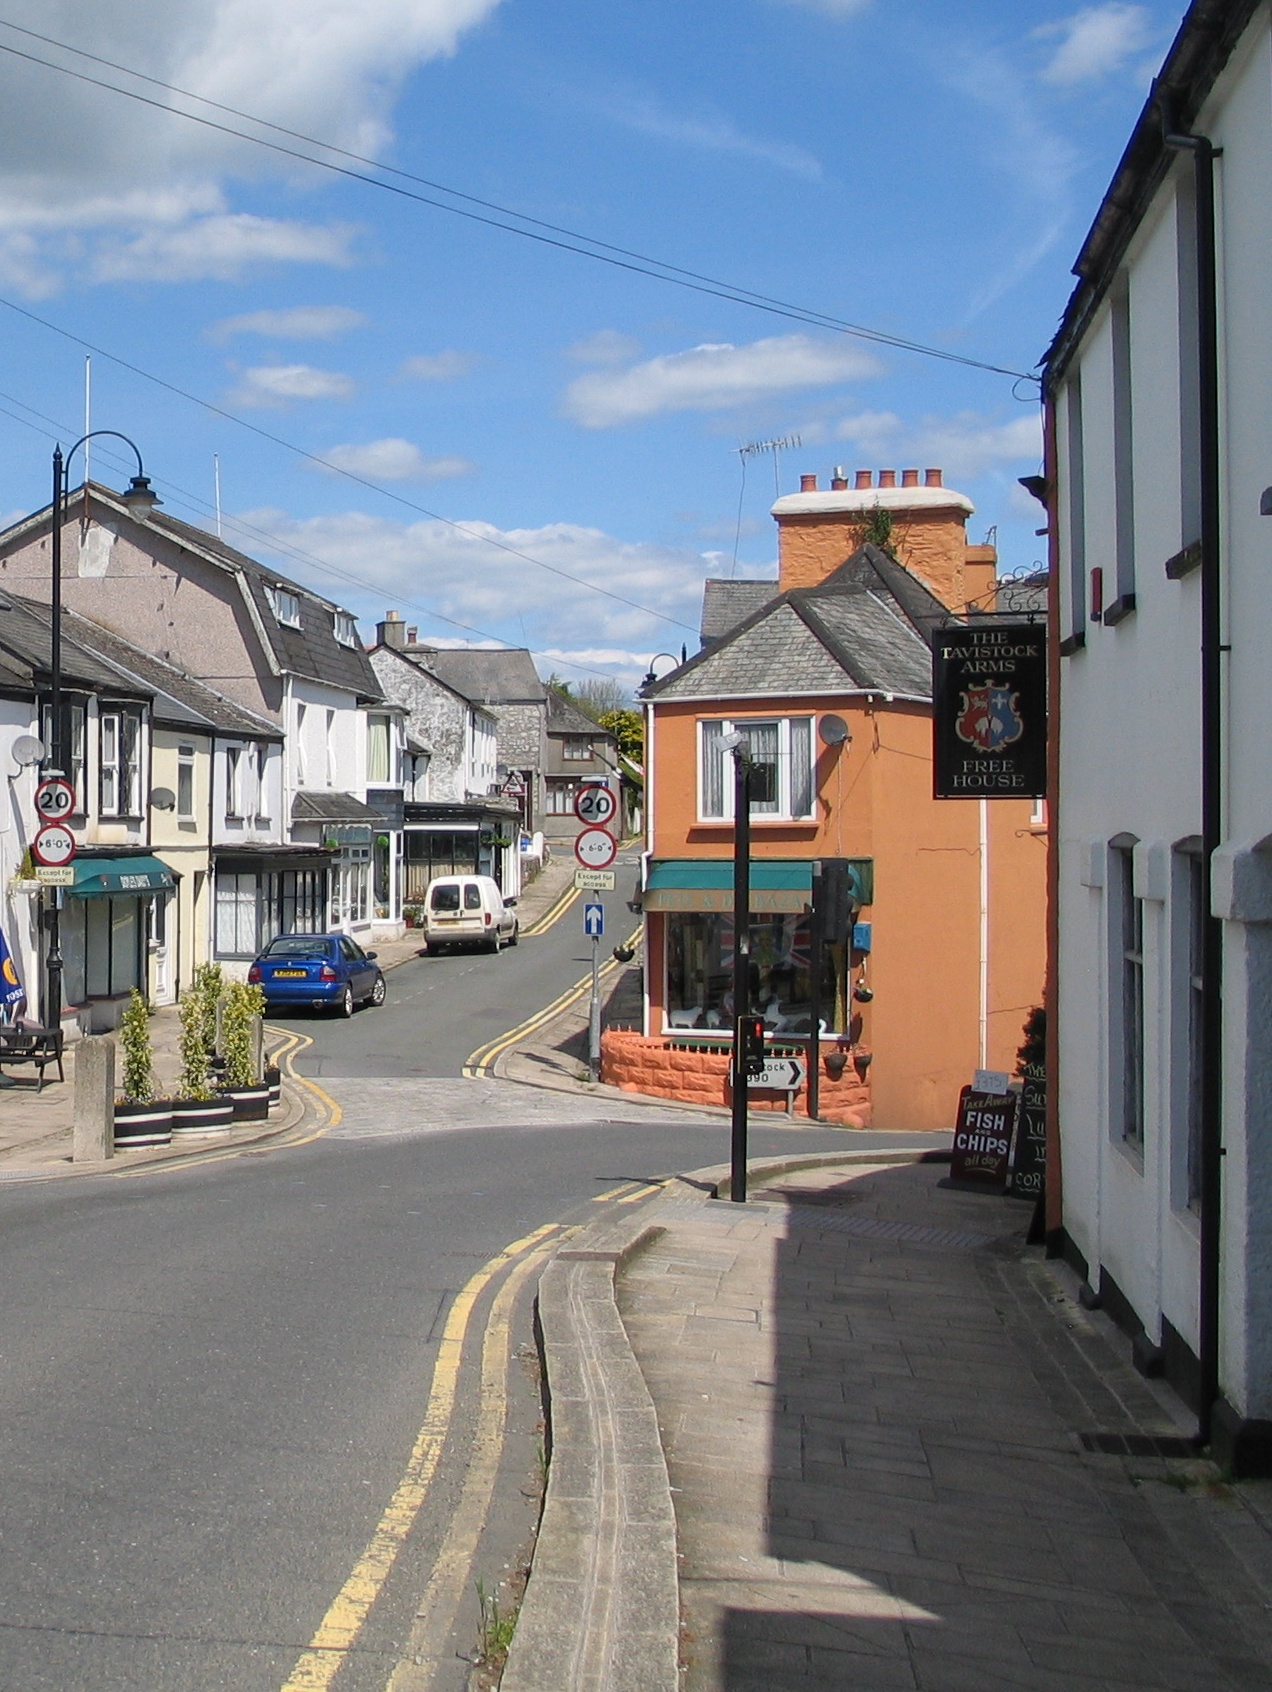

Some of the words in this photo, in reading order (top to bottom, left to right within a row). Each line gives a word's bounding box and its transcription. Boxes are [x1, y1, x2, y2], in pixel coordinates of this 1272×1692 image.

[970, 632, 1008, 645] THE
[940, 645, 1038, 659] TAVISTOCK
[960, 660, 1016, 673] ARMS
[962, 760, 1014, 773] FREE
[952, 774, 1025, 787] HOUSE
[40, 791, 69, 809] 20
[581, 796, 610, 814] 20
[578, 872, 602, 881] Except
[966, 1111, 1005, 1131] FISH
[957, 1133, 1008, 1155] CHIPS
[981, 1155, 1001, 1169] day
